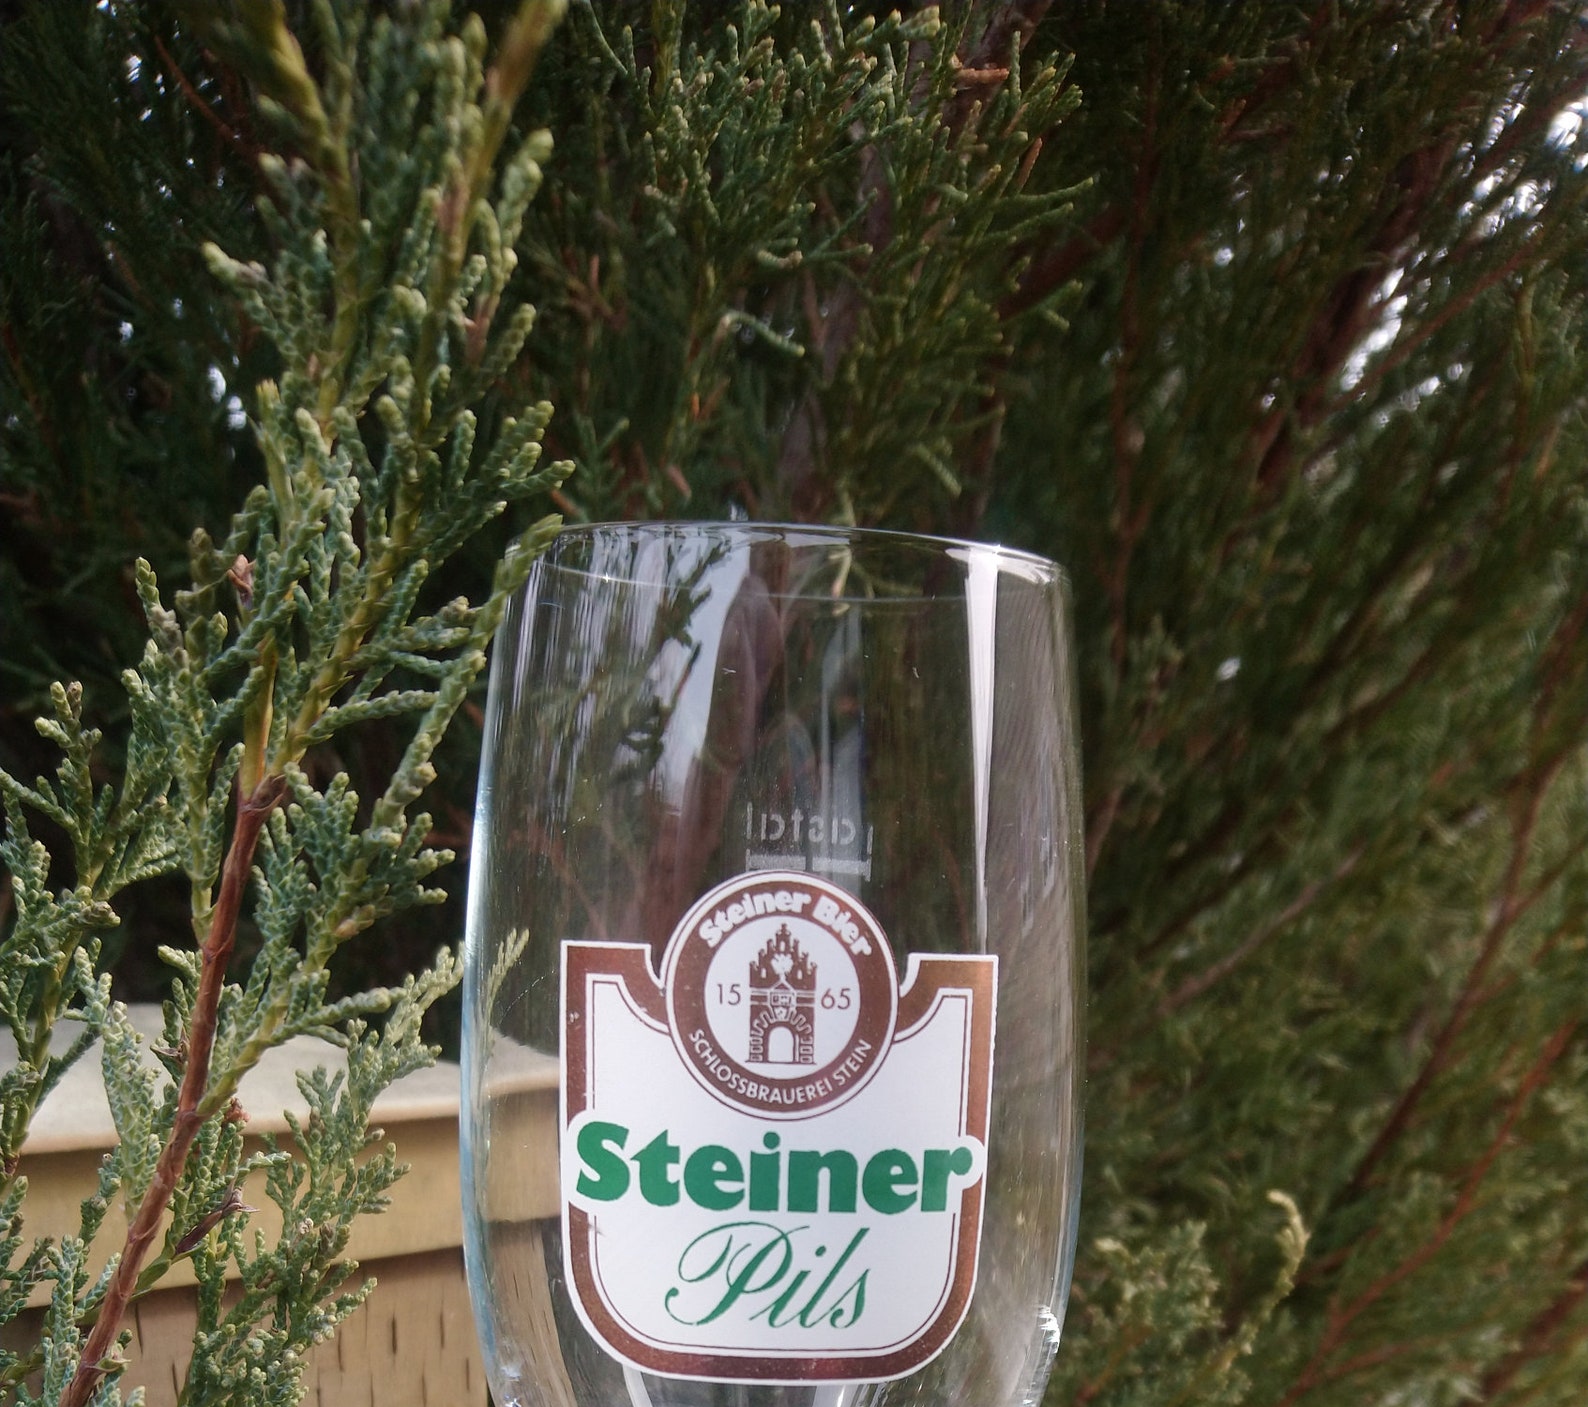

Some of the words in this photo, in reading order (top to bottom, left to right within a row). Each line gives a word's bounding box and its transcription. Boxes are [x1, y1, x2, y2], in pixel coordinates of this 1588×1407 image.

[699, 890, 812, 948] Steiner
[813, 895, 872, 956] Bier
[716, 983, 742, 1006] 15
[820, 988, 852, 1010] 65
[689, 1029, 833, 1104] SCHLOSSBRAUEREI
[833, 1039, 872, 1086] STEIN
[576, 1121, 973, 1214] Steiner
[664, 1222, 871, 1329] Pils
